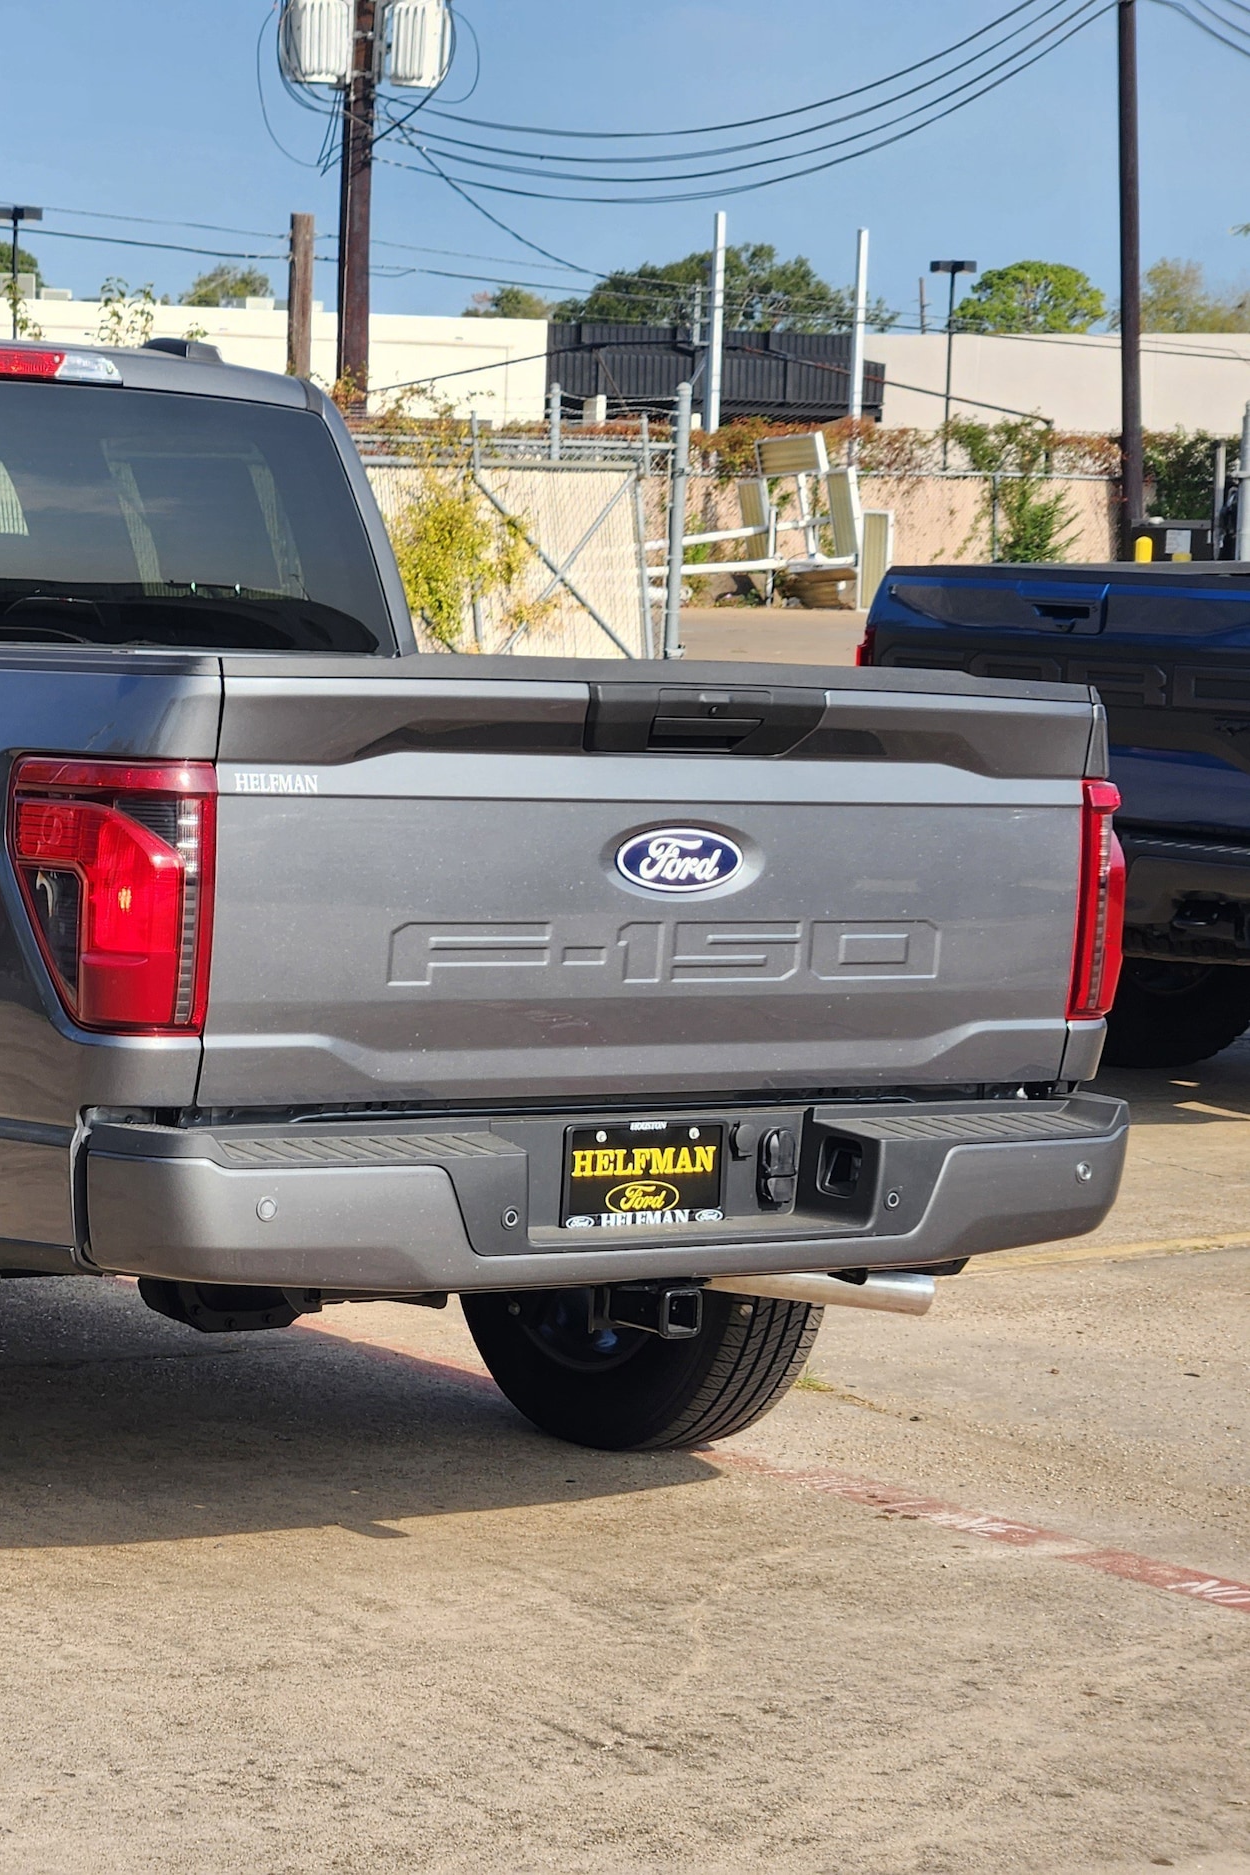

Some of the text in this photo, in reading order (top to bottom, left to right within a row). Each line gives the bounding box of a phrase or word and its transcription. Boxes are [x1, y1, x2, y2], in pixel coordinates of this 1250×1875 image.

[234, 773, 318, 794] HELFMAN
[639, 837, 723, 881] Ford
[386, 919, 943, 987] F-150
[630, 1121, 668, 1131] HOUSTON
[571, 1146, 717, 1177] HELFMAN
[619, 1184, 667, 1211] Ford
